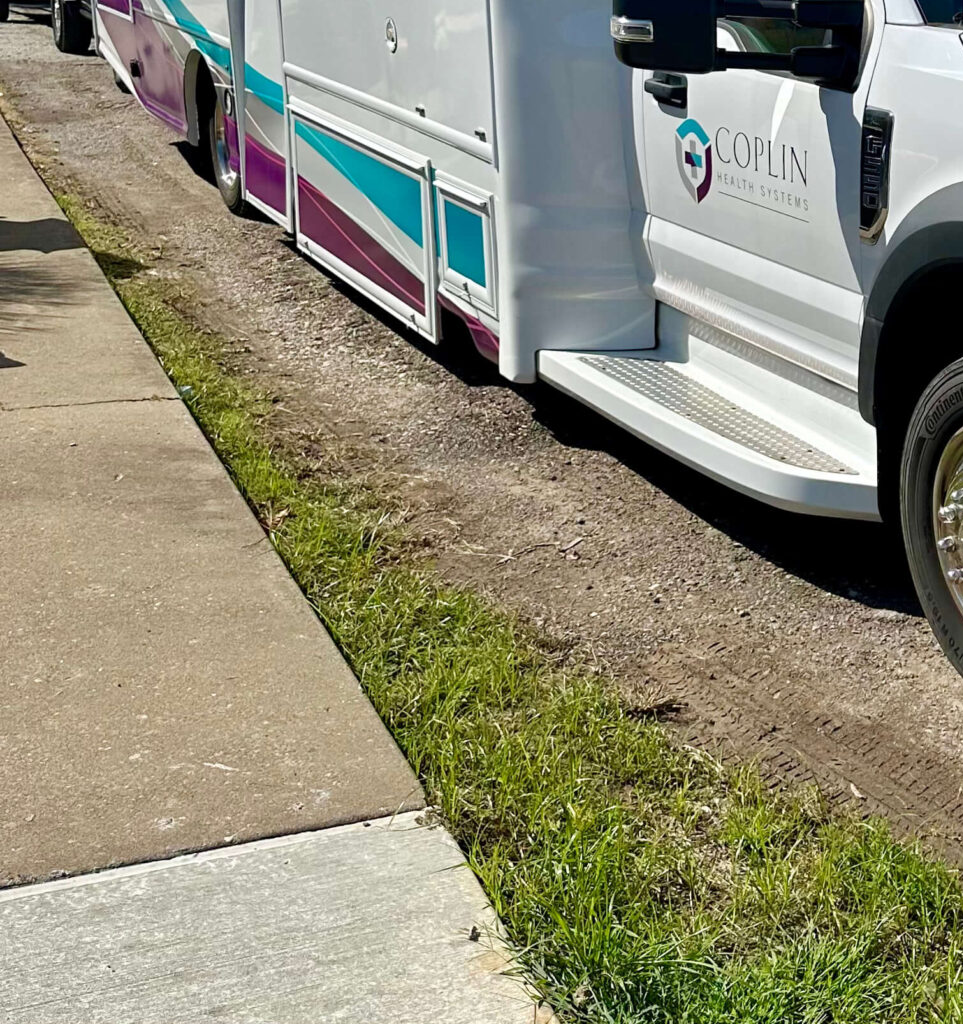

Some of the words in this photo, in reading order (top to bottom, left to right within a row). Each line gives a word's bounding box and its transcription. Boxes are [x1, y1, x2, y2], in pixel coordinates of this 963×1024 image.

[715, 126, 808, 187] COPLIN
[716, 171, 755, 194] HEALTH
[760, 184, 809, 212] SYSTEMS
